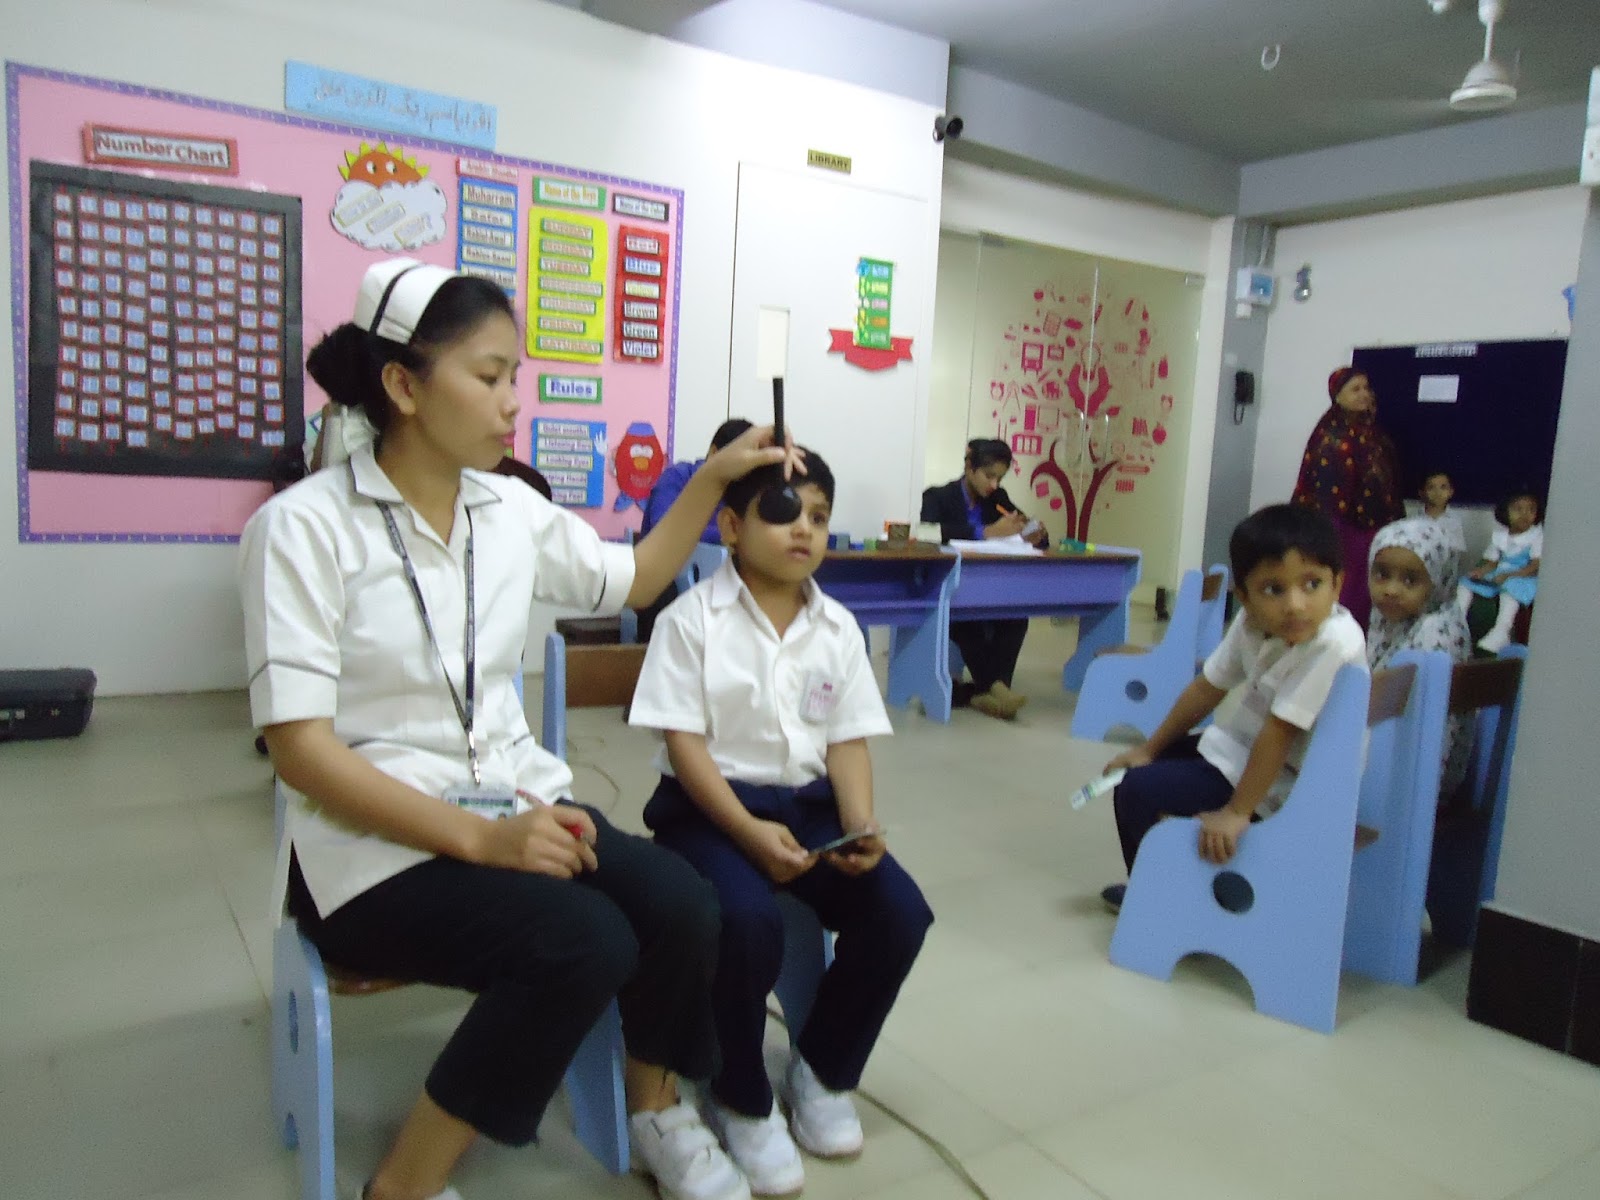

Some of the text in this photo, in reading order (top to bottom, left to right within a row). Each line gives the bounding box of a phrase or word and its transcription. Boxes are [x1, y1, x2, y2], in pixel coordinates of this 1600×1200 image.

[98, 133, 225, 163] Number Chart
[810, 152, 848, 169] LIBRARY
[626, 302, 655, 318] Brown
[625, 322, 655, 338] Green
[625, 341, 655, 357] Violet
[550, 379, 593, 394] Rules
